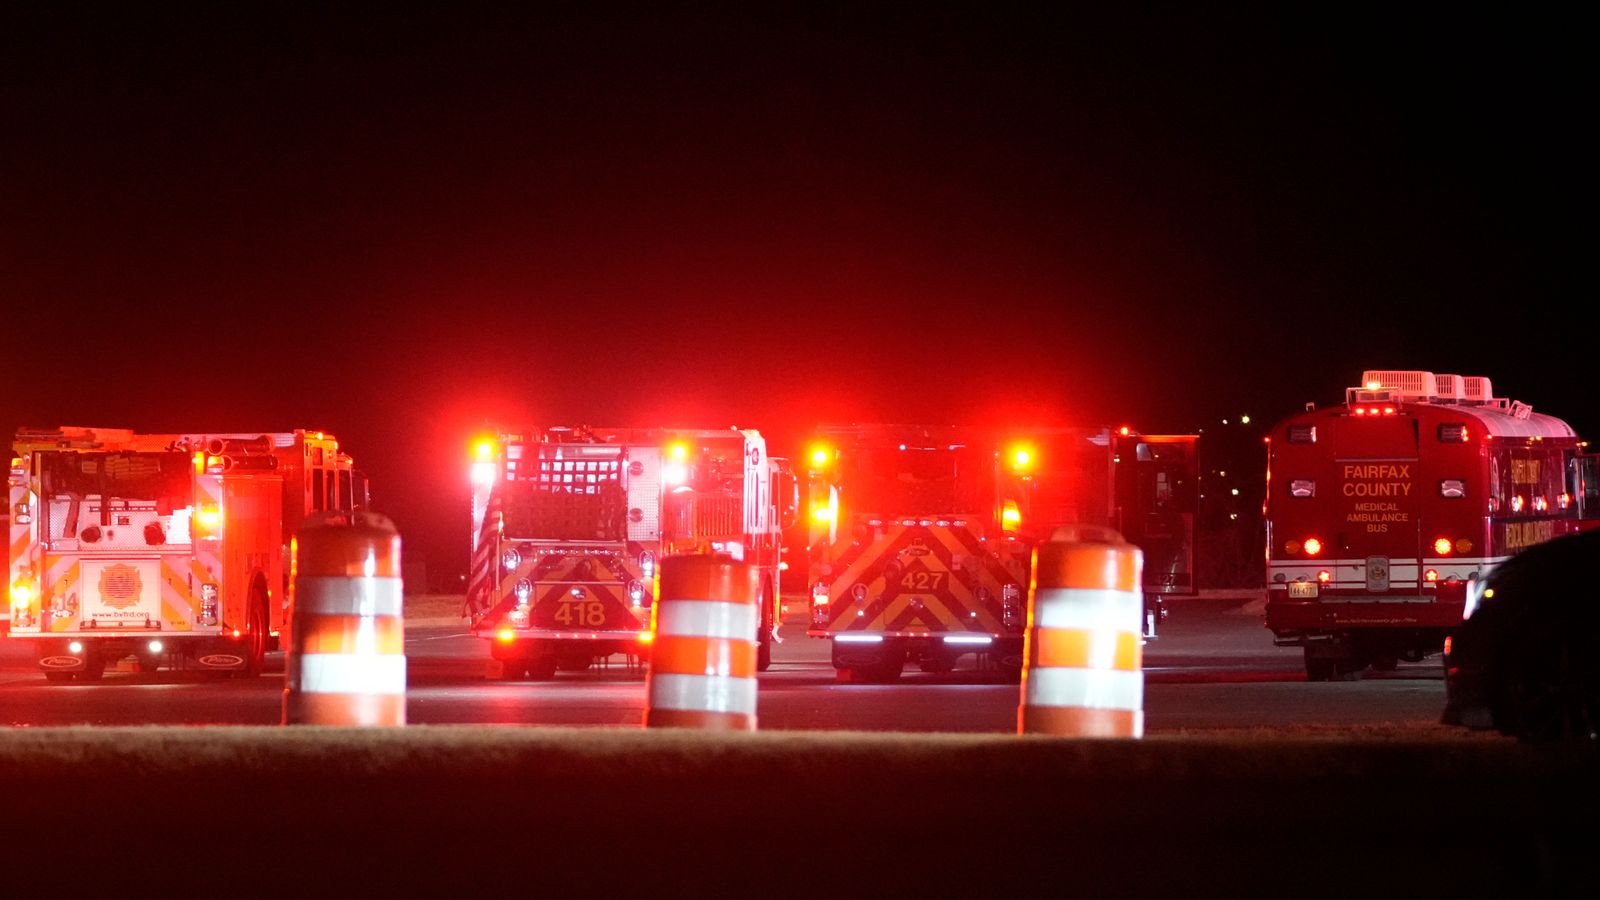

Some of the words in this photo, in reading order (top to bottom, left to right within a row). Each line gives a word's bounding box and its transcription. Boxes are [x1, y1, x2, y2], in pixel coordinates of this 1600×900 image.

[1344, 465, 1410, 478] FAIRFAX
[1343, 482, 1411, 496] COUNTY
[1355, 502, 1399, 511] MEDICAL
[1346, 513, 1409, 522] AMBULANCE
[1367, 524, 1388, 533] BUS
[900, 572, 943, 589] 427
[554, 602, 606, 626] 418
